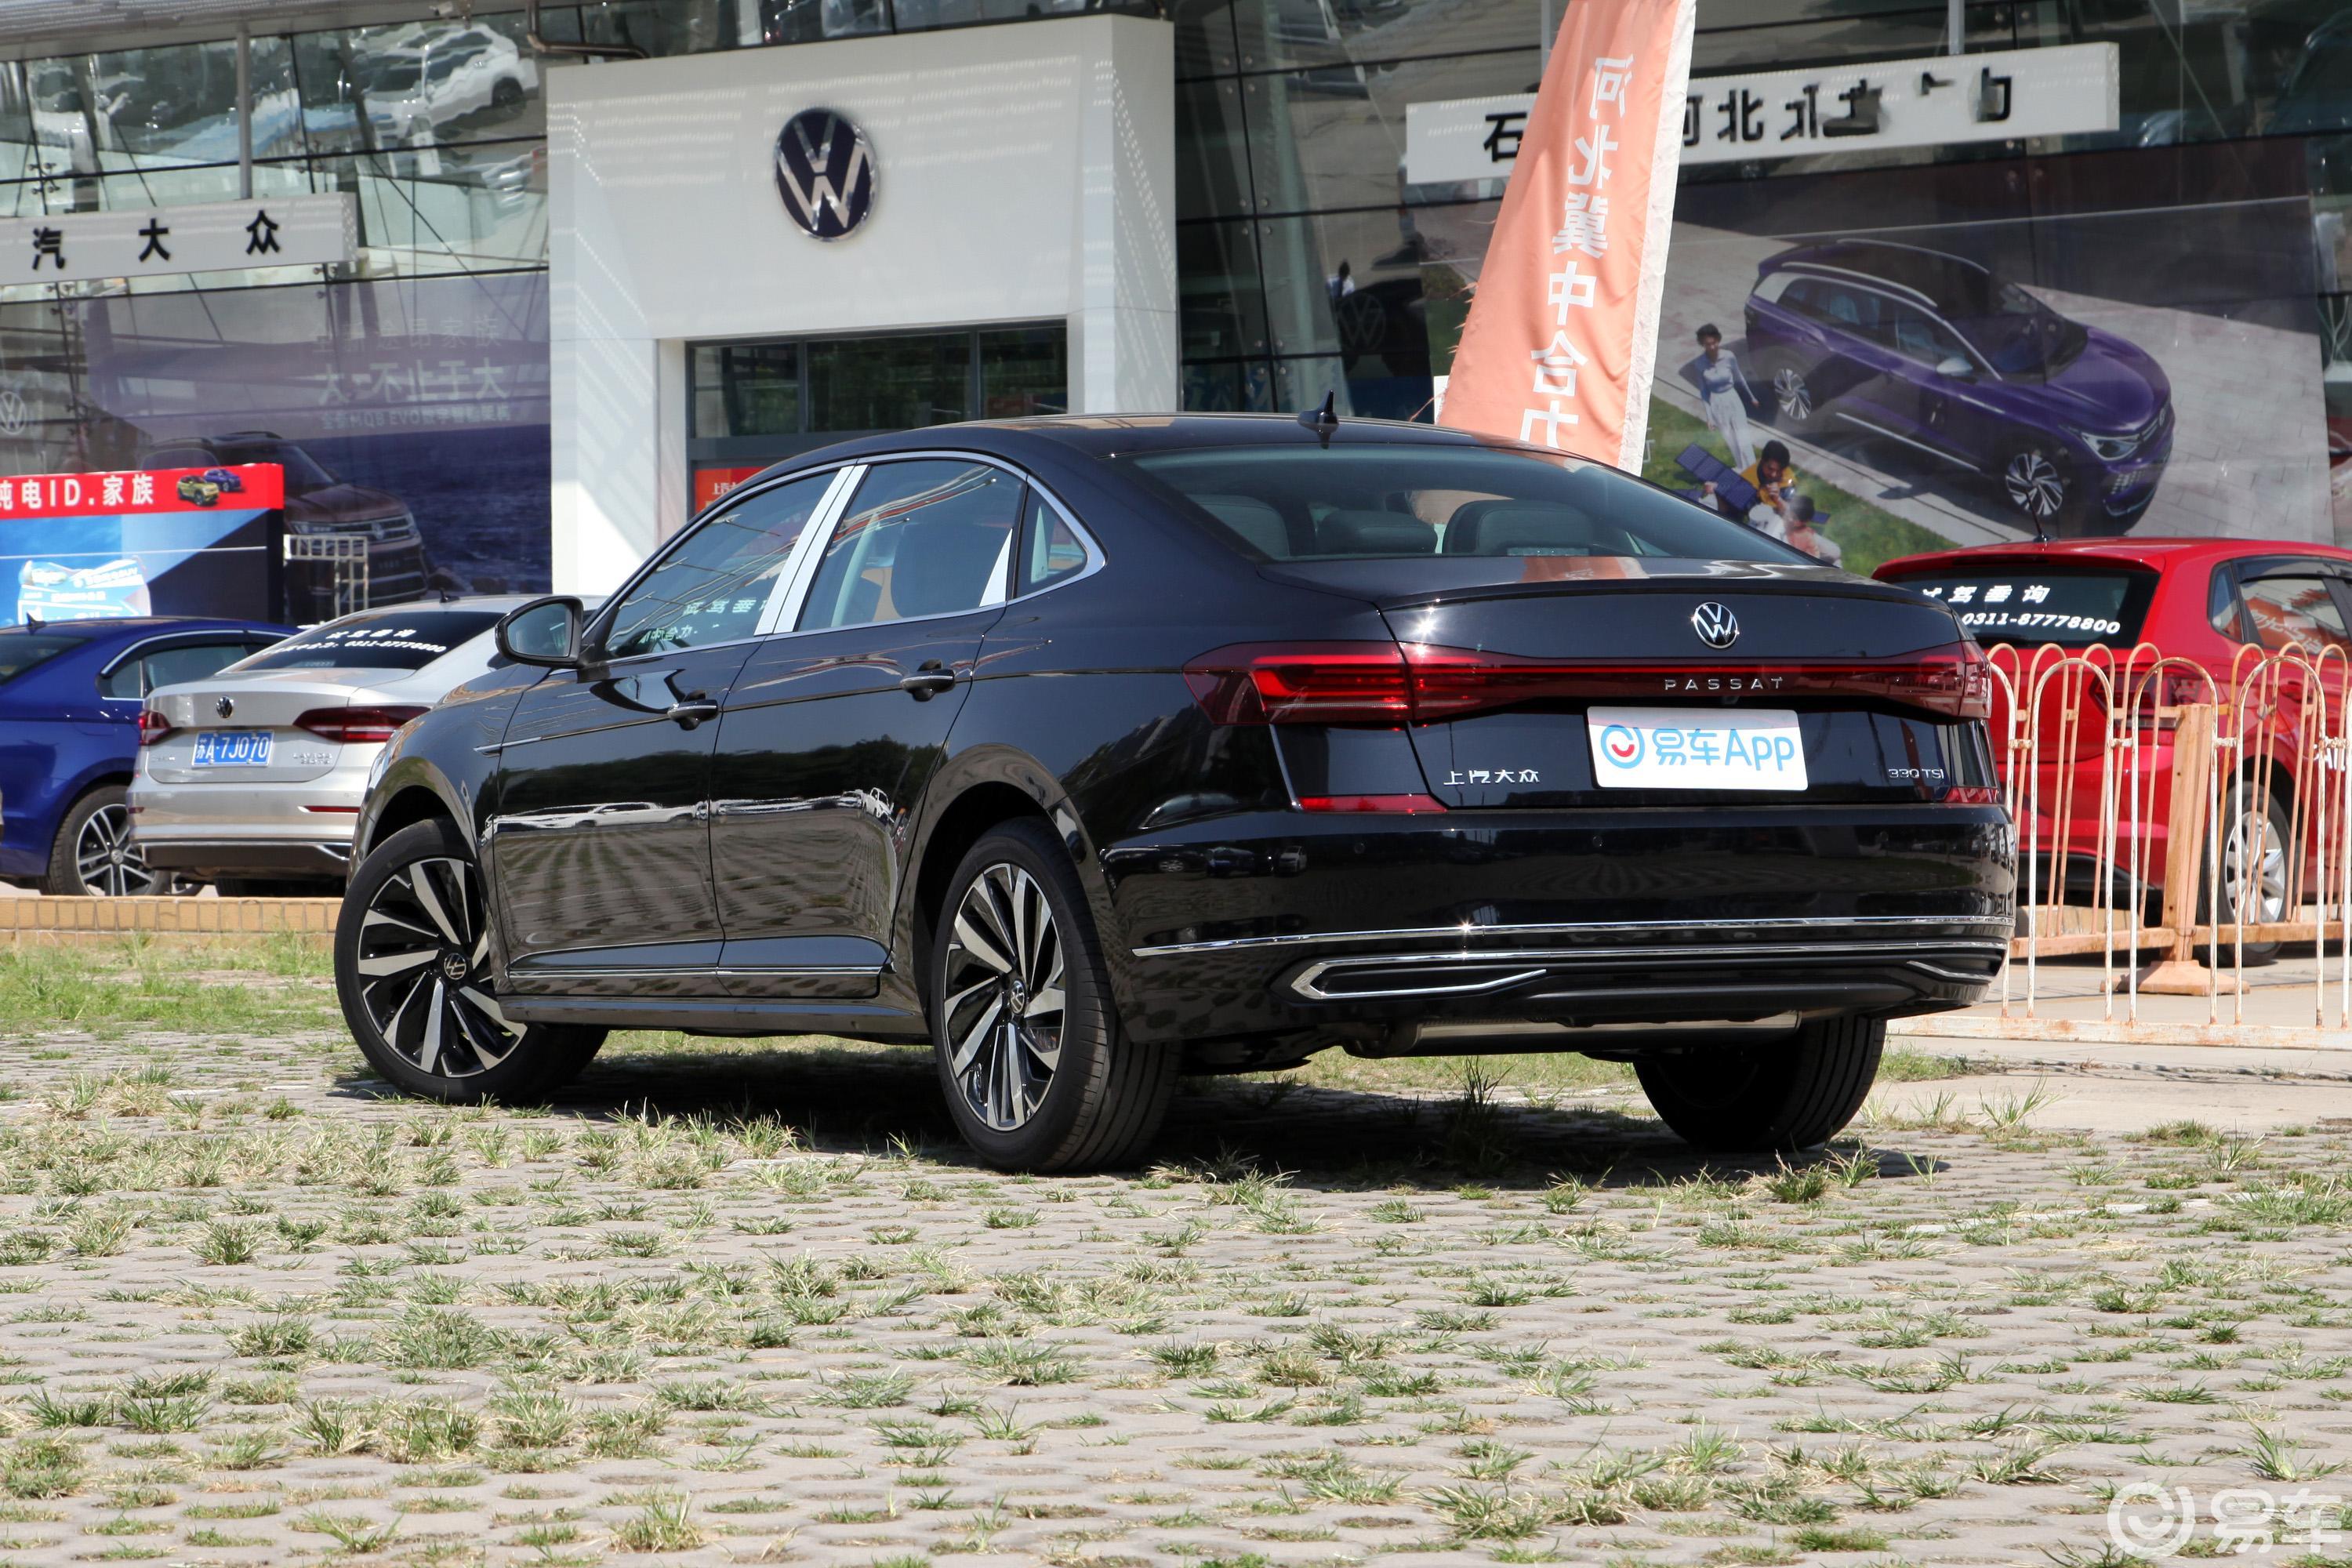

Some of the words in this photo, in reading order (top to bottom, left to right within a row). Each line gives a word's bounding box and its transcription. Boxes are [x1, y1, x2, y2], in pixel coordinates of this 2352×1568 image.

[1962, 612, 2122, 635] 0311-87778800
[1664, 677, 1783, 691] PASSAT
[1443, 768, 1541, 786] 上汽大众
